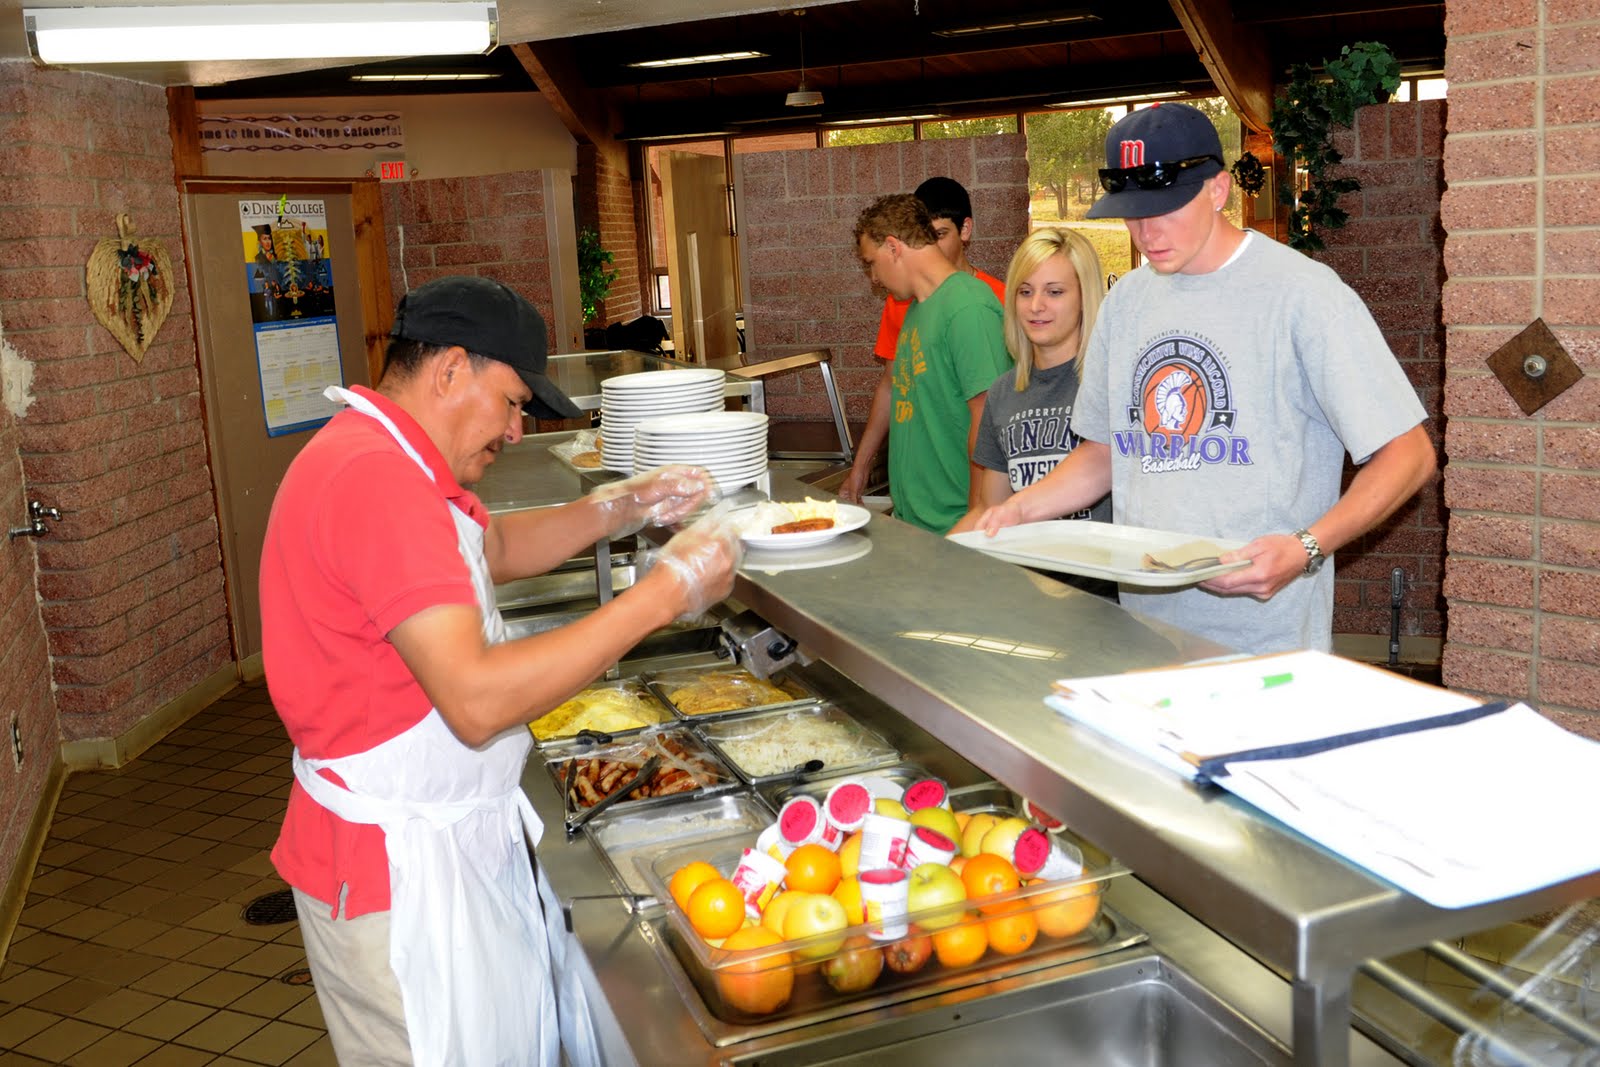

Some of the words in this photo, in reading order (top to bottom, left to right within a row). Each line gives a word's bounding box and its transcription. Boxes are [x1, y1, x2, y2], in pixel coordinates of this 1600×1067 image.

[225, 129, 237, 139] to
[241, 128, 260, 138] the
[295, 127, 340, 138] College
[381, 162, 404, 179] EXIT
[1200, 355, 1227, 409] RECORD
[1010, 407, 1062, 422] PROPERTY
[1141, 452, 1201, 474] Basketball
